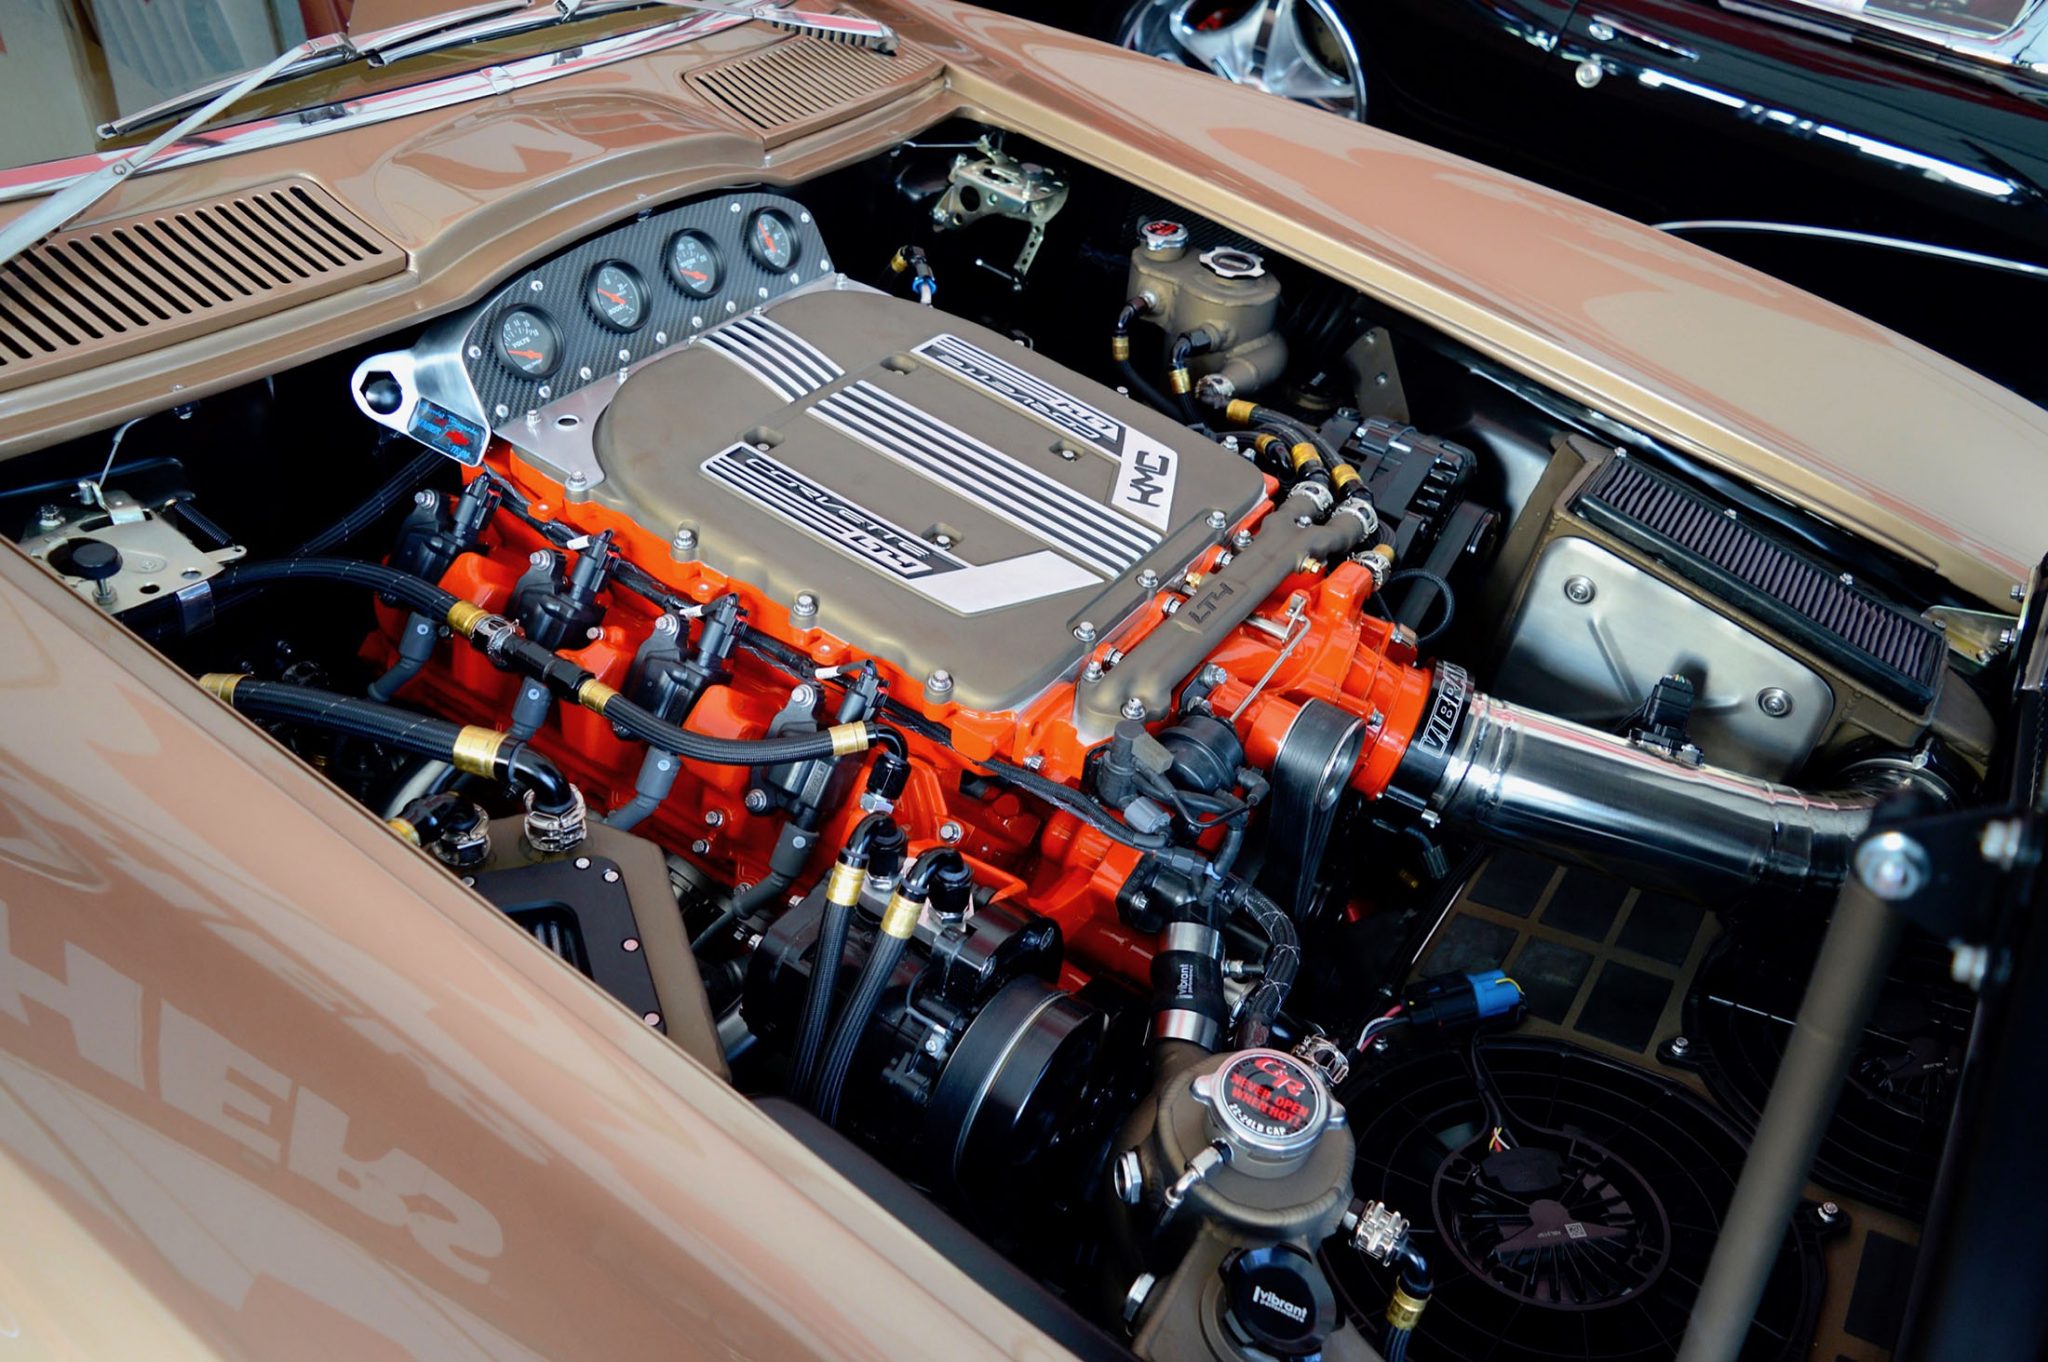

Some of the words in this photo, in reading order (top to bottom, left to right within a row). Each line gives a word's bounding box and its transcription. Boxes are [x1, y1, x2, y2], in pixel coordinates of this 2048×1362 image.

[512, 336, 530, 349] VOLTS
[936, 353, 1101, 440] CORVETTE
[746, 457, 931, 559] CORVETTE
[1188, 582, 1235, 625] LT4
[1176, 963, 1189, 995] vibrant
[1230, 1073, 1272, 1100] NEVER
[1275, 1096, 1310, 1118] OPEN
[1231, 1086, 1268, 1113] WHEN
[1266, 1125, 1287, 1136] CAP
[1259, 1288, 1308, 1319] vibrant
